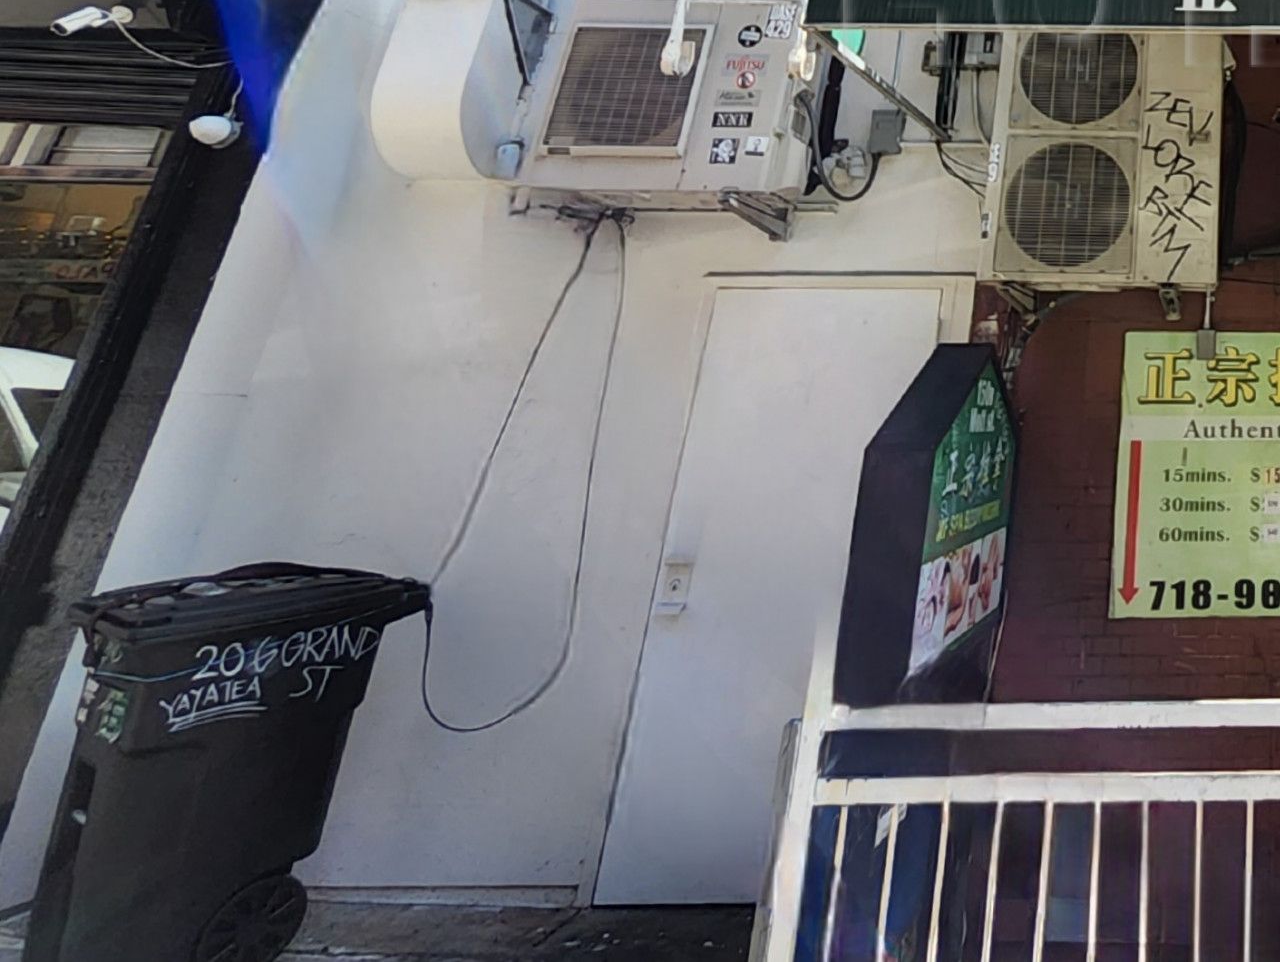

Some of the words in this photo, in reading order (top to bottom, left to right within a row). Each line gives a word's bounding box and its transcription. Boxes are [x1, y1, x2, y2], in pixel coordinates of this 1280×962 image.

[726, 55, 766, 71] FUJITSU
[1163, 467, 1232, 483] 15mins.
[1159, 496, 1232, 512] 30mins.
[1158, 525, 1231, 542] 60mins.
[281, 623, 380, 668] GRAND
[288, 664, 345, 703] ST
